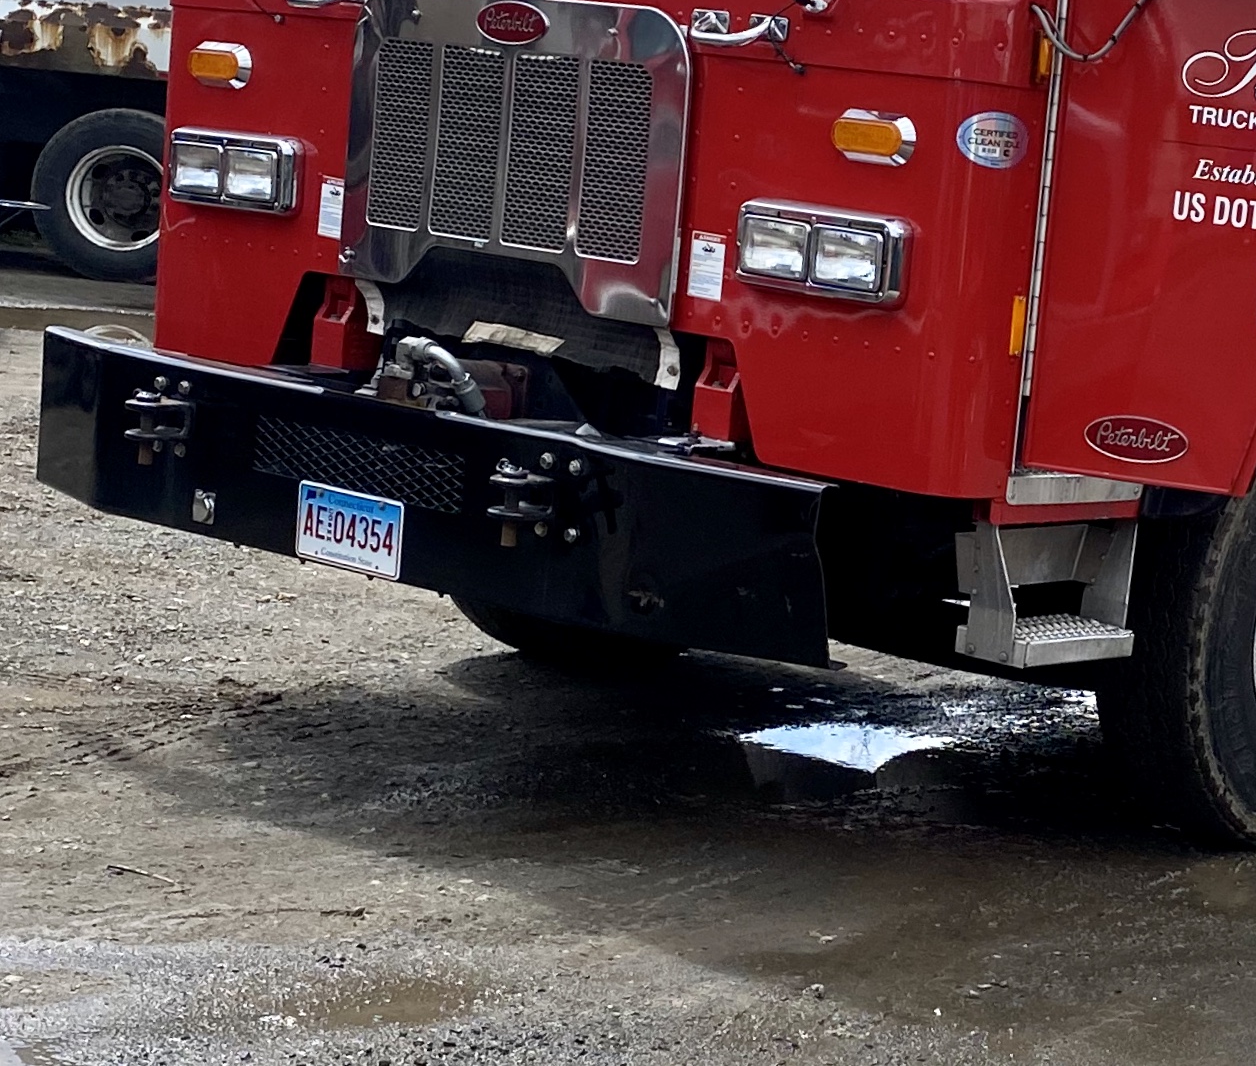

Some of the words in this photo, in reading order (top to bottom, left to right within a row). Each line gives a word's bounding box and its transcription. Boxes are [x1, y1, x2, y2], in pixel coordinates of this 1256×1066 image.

[484, 7, 540, 32] Peterbilt
[967, 137, 1001, 147] CLEAN
[1172, 190, 1206, 222] US
[1096, 421, 1179, 452] Peterbilt
